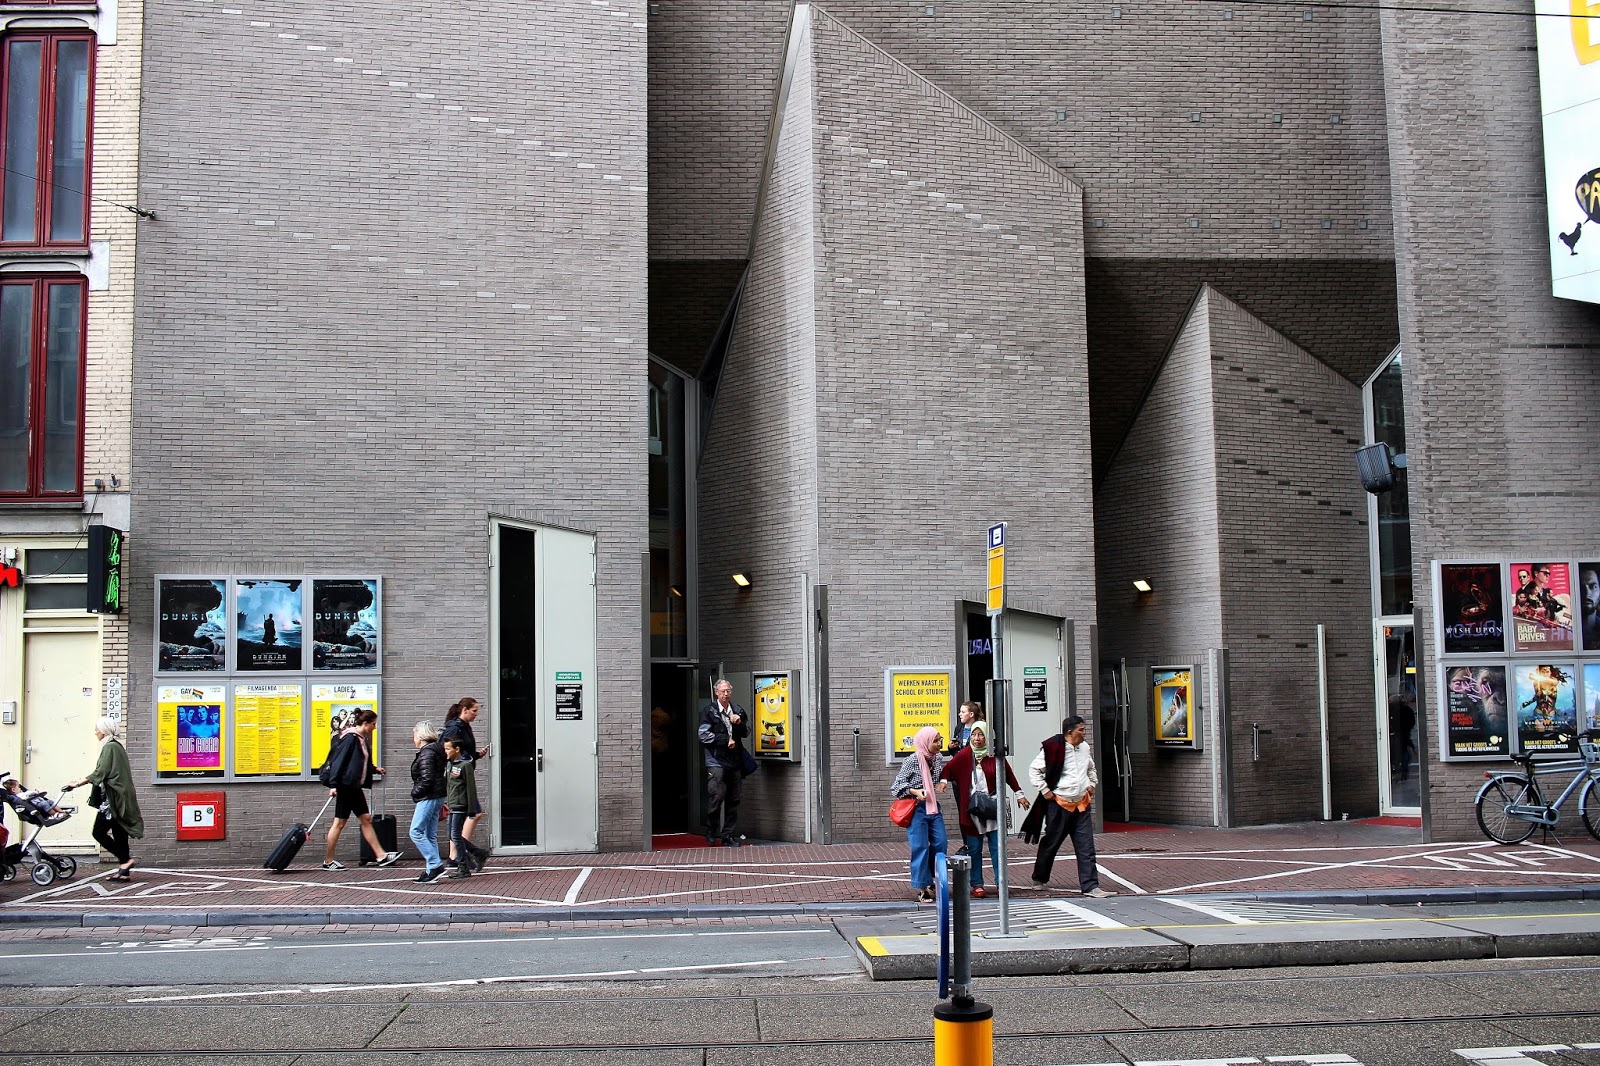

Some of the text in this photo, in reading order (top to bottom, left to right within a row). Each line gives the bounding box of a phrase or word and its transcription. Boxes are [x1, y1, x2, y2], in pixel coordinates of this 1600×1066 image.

[162, 613, 223, 621] DUNKIRK
[315, 612, 374, 620] DUNKIRK
[1475, 626, 1503, 634] UPON
[1517, 625, 1537, 633] BABY
[1517, 632, 1545, 641] DRIVER
[109, 689, 120, 699] 5D
[109, 700, 120, 711] 5C
[178, 737, 195, 754] KING
[194, 810, 203, 822] B
